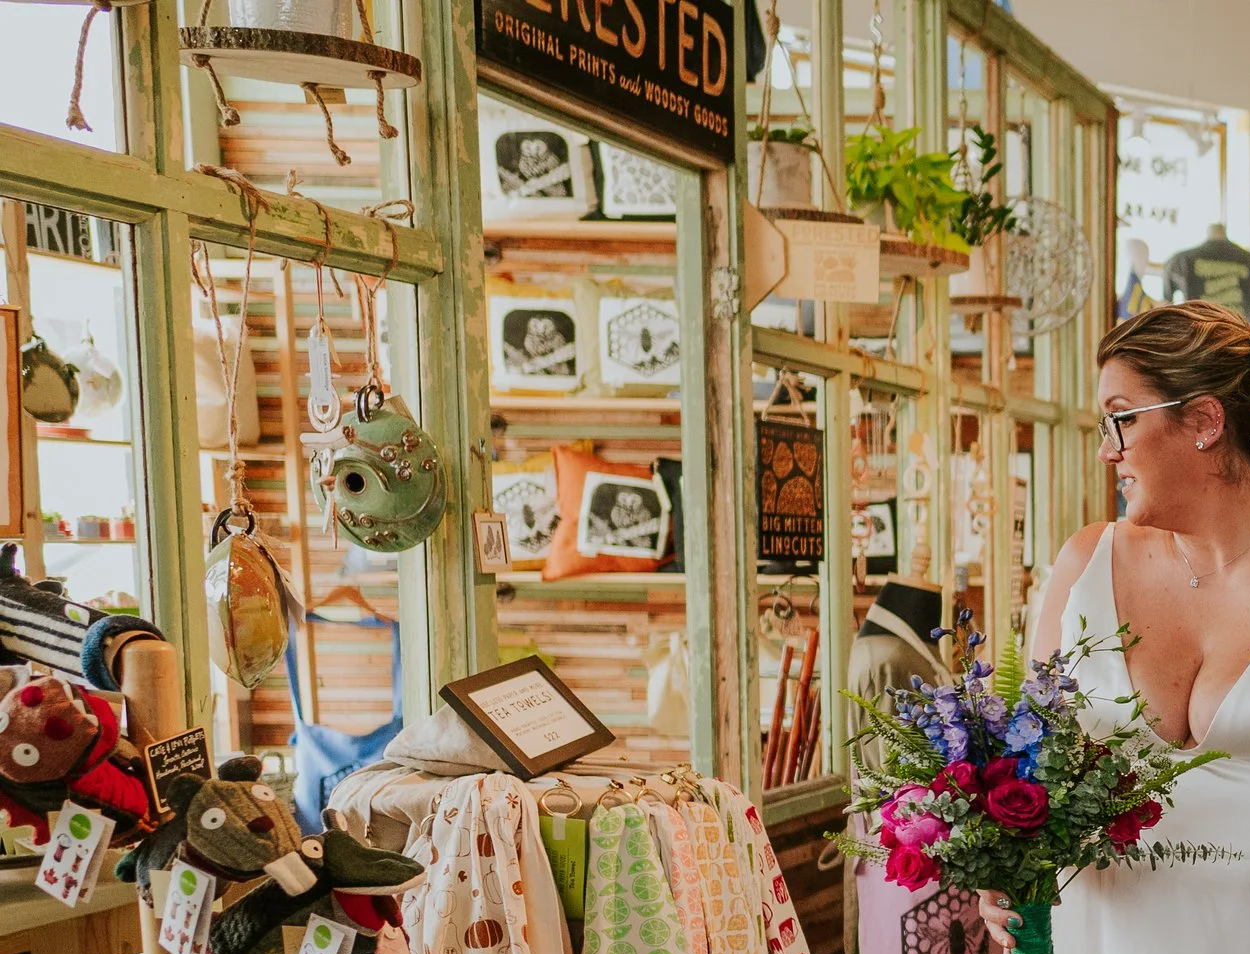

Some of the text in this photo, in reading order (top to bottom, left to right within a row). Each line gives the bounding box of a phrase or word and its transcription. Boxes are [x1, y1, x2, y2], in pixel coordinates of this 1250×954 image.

[494, 9, 729, 137] ORIGINAL PRINTS and WOODSY GOODS
[762, 515, 822, 534] BIG MITTEN
[488, 707, 512, 721] TEA
